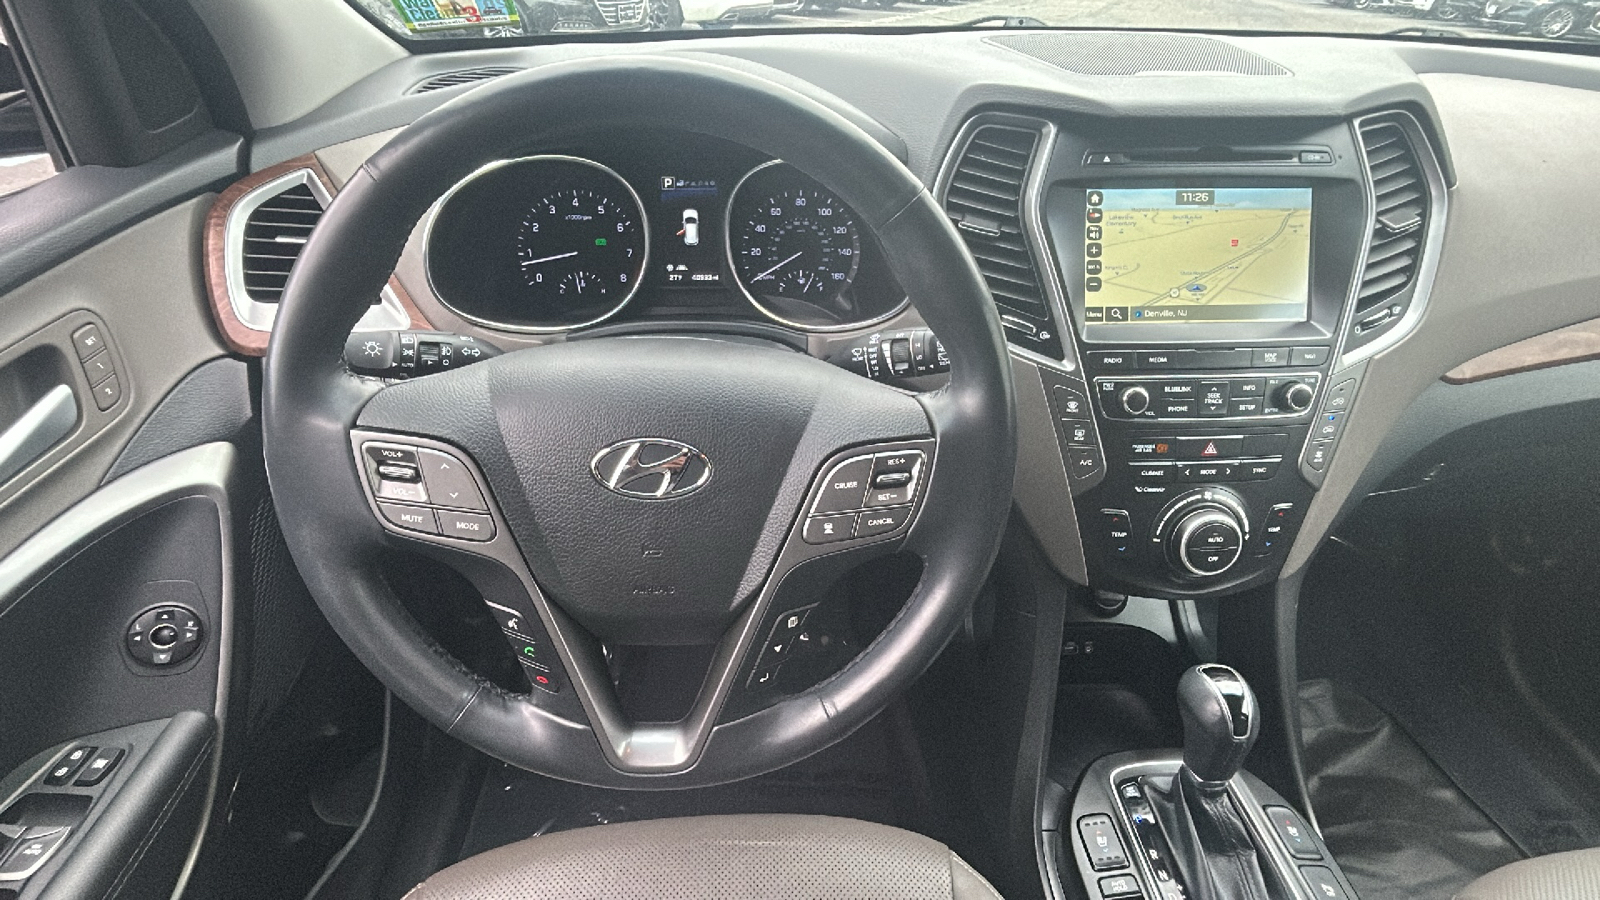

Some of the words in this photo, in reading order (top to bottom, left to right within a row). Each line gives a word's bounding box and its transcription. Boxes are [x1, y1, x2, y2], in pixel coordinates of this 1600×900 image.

[664, 178, 672, 188] P
[1182, 192, 1209, 202] 11:26
[572, 198, 579, 207] 4
[795, 198, 806, 206] 80
[549, 205, 556, 214] 3
[598, 205, 604, 214] 5
[770, 208, 782, 216] 60
[818, 208, 832, 216] 100
[532, 223, 539, 232] 2
[617, 223, 624, 232] 6
[754, 224, 766, 232] 40
[832, 226, 847, 234] 120
[527, 248, 532, 258] 1
[626, 248, 633, 258] 7
[750, 248, 762, 256] 20
[838, 248, 852, 256] 140
[536, 273, 542, 282] 0
[620, 274, 627, 282] 8
[831, 272, 845, 280] 160
[1144, 308, 1176, 318] Denville,
[834, 481, 858, 490] CRUISE
[402, 514, 424, 523] MUTE
[868, 518, 894, 526] CANCEL
[456, 522, 480, 531] MODE
[1149, 849, 1158, 860] R
[1158, 870, 1168, 880] N
